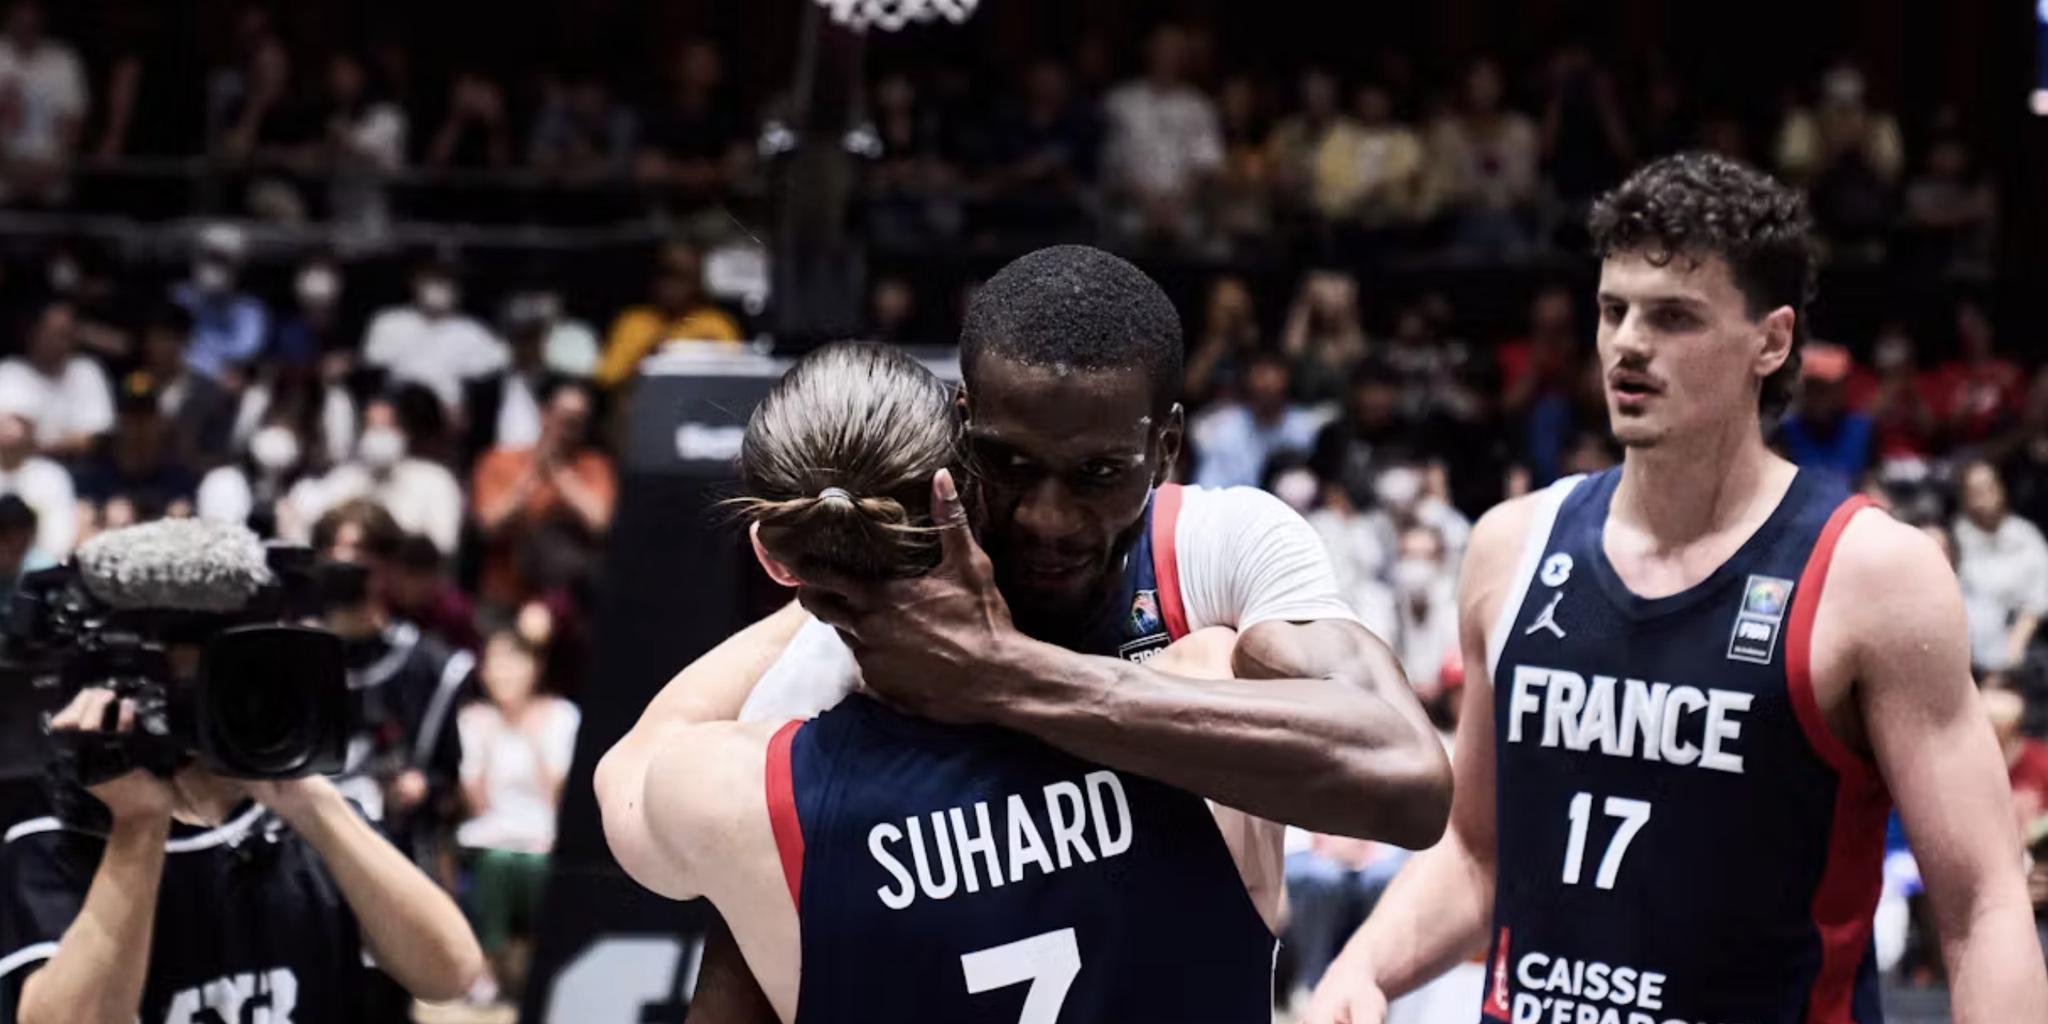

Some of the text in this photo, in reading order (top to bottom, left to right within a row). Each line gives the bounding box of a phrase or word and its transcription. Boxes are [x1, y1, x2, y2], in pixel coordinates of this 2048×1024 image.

[1508, 664, 1755, 774] FRANCE
[867, 770, 1133, 910] SUHARD
[1562, 791, 1652, 890] 17
[959, 927, 1082, 1024] 7
[1511, 992, 1708, 1024] D'EP
[1516, 952, 1667, 1010] CAISSE
